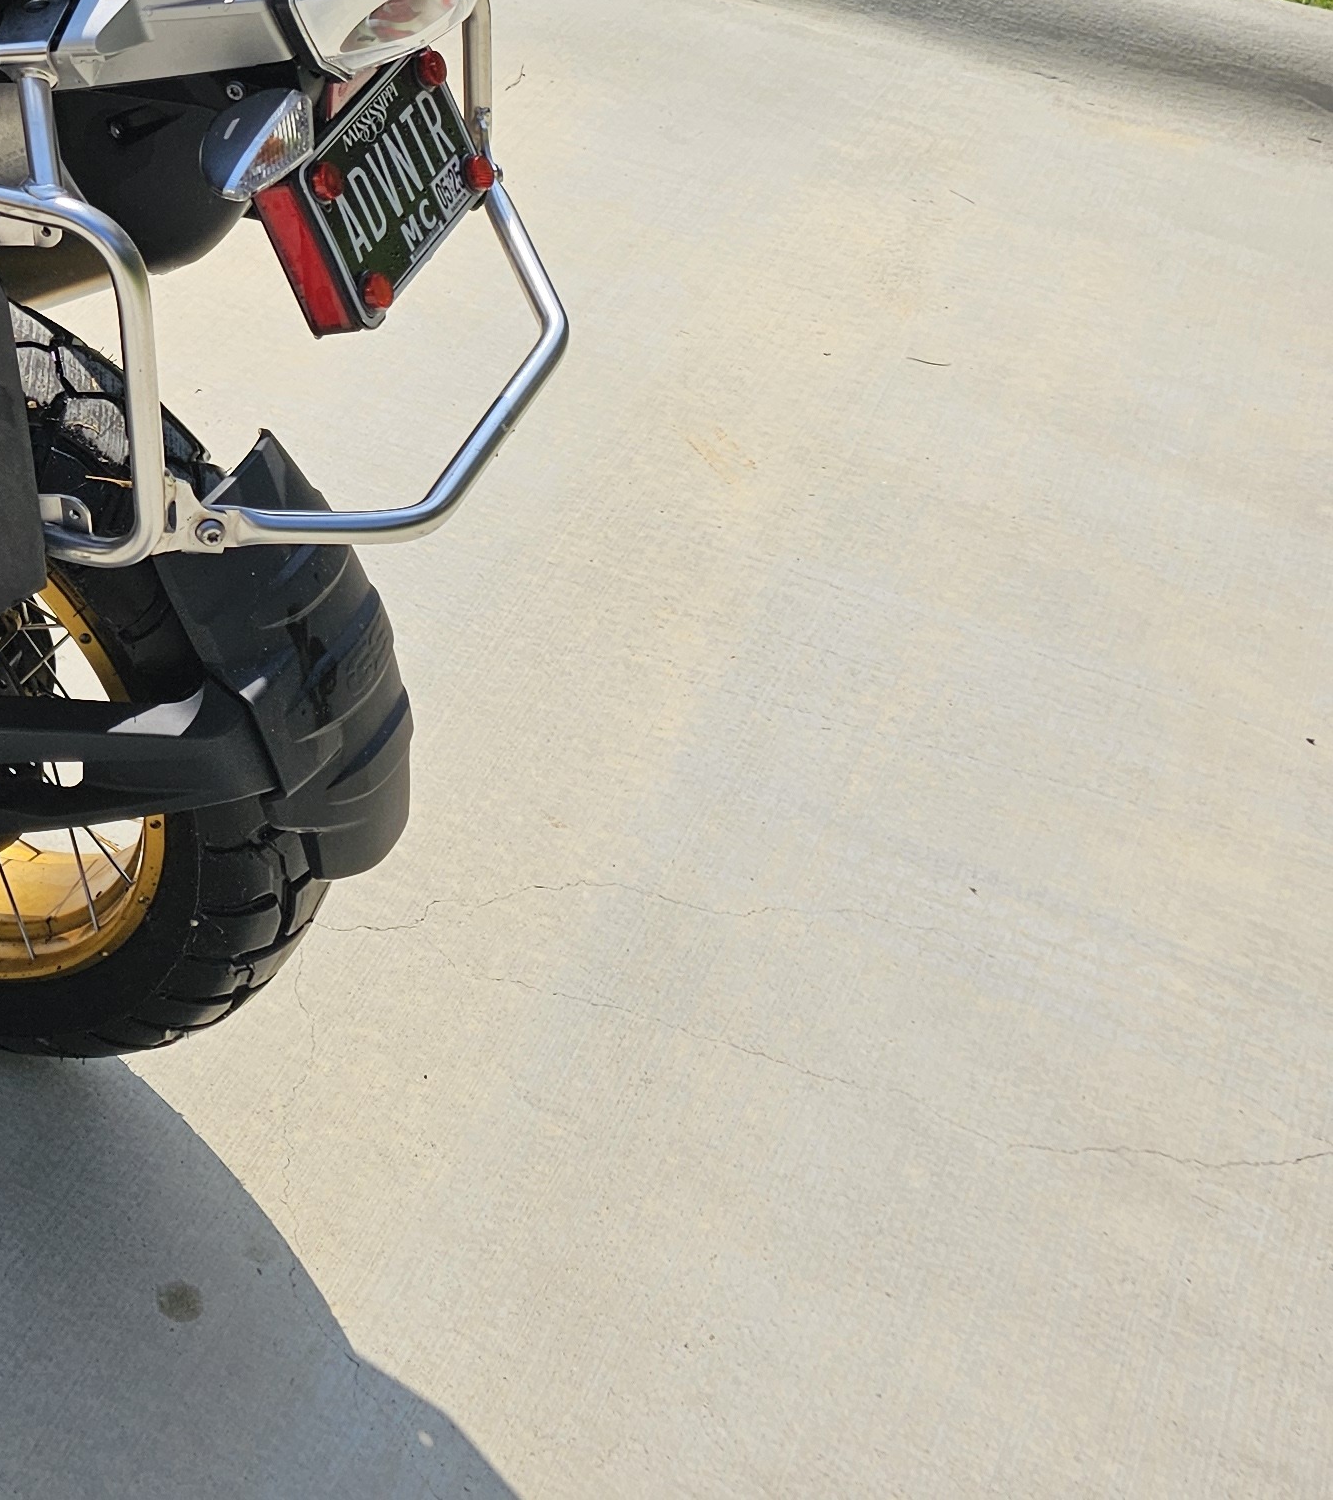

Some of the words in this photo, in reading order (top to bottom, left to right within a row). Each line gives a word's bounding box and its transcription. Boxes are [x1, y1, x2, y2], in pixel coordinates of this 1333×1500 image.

[342, 81, 400, 153] MISSISSIPPI
[336, 90, 456, 264] ADVNTR
[400, 198, 437, 252] MC
